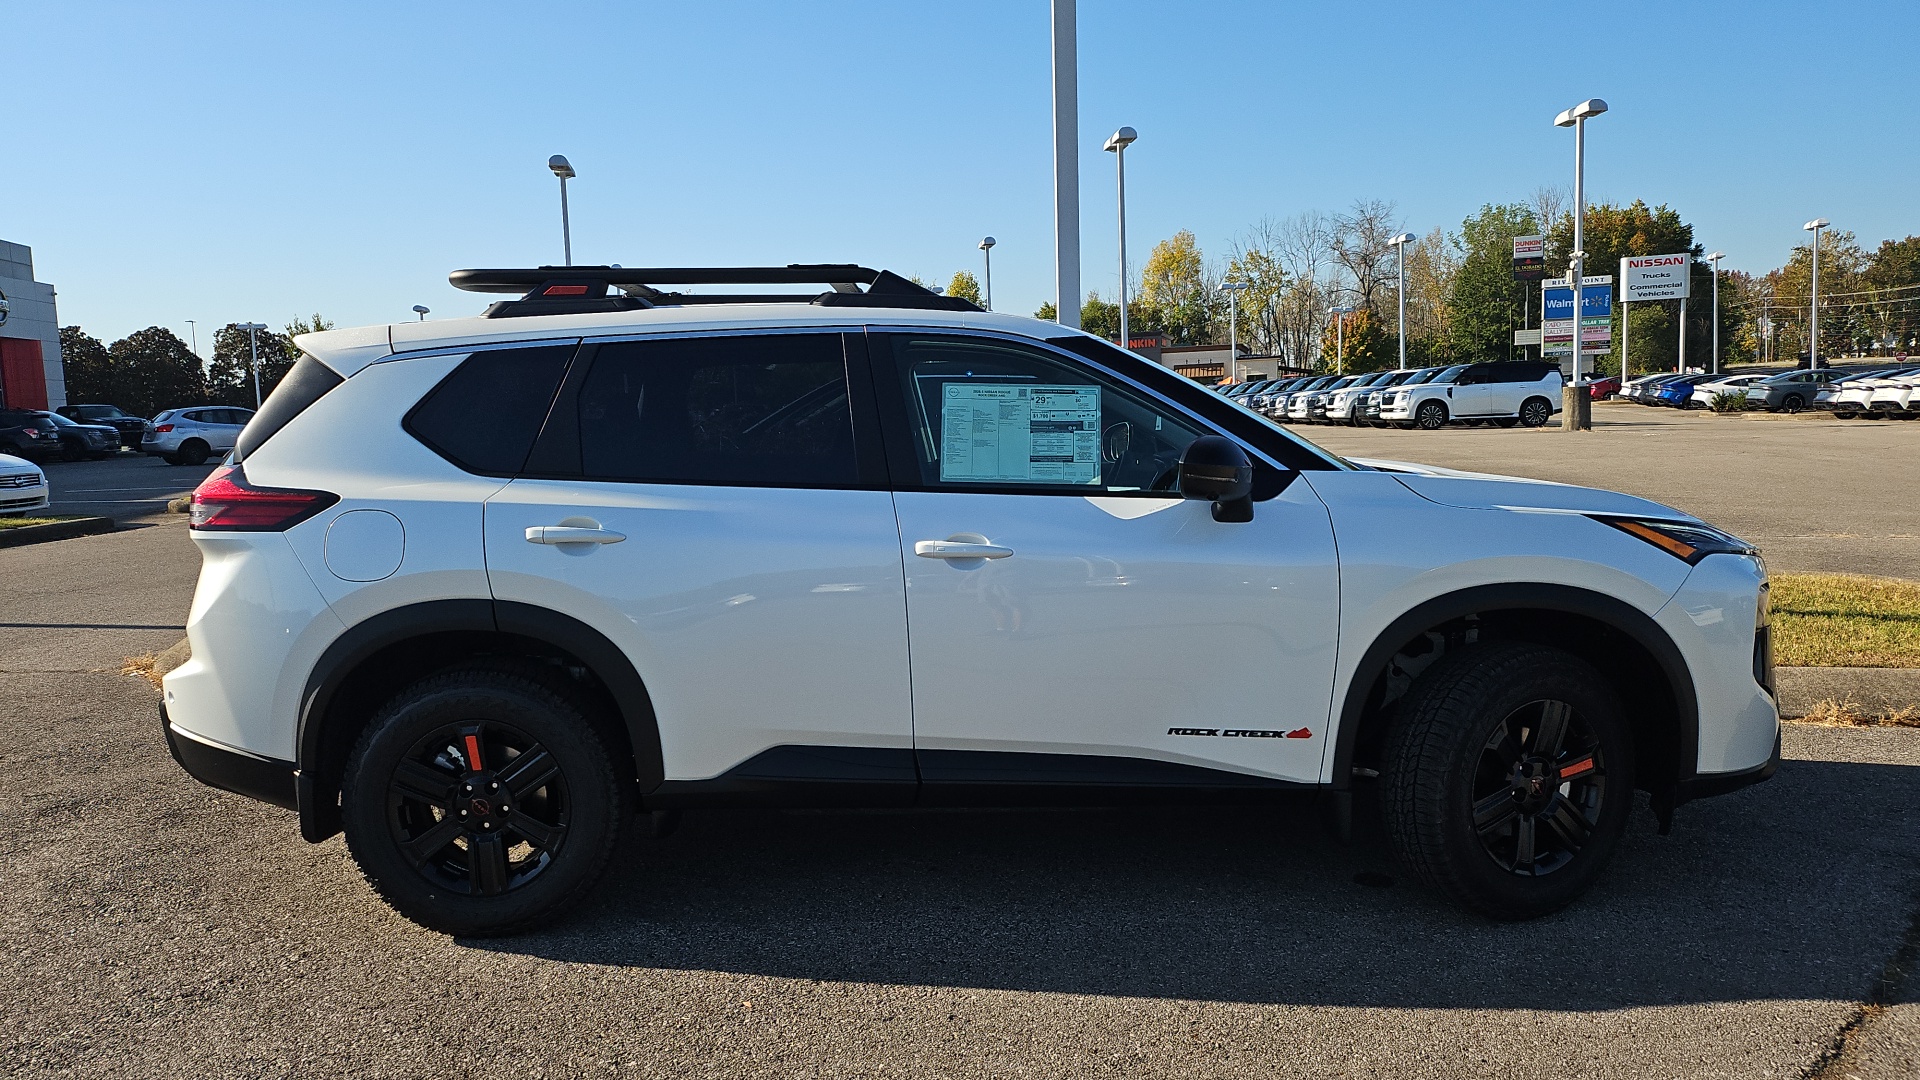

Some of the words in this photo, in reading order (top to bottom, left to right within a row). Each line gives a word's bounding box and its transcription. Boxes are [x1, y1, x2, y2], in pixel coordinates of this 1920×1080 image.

[1629, 257, 1684, 268] NISSAN
[1552, 277, 1605, 285] RIVOINT
[1629, 282, 1683, 290] Commercial
[1546, 297, 1590, 308] Walmrt
[1035, 396, 1046, 404] 29
[1167, 727, 1221, 737] ROCK
[1222, 729, 1286, 739] CREEK
